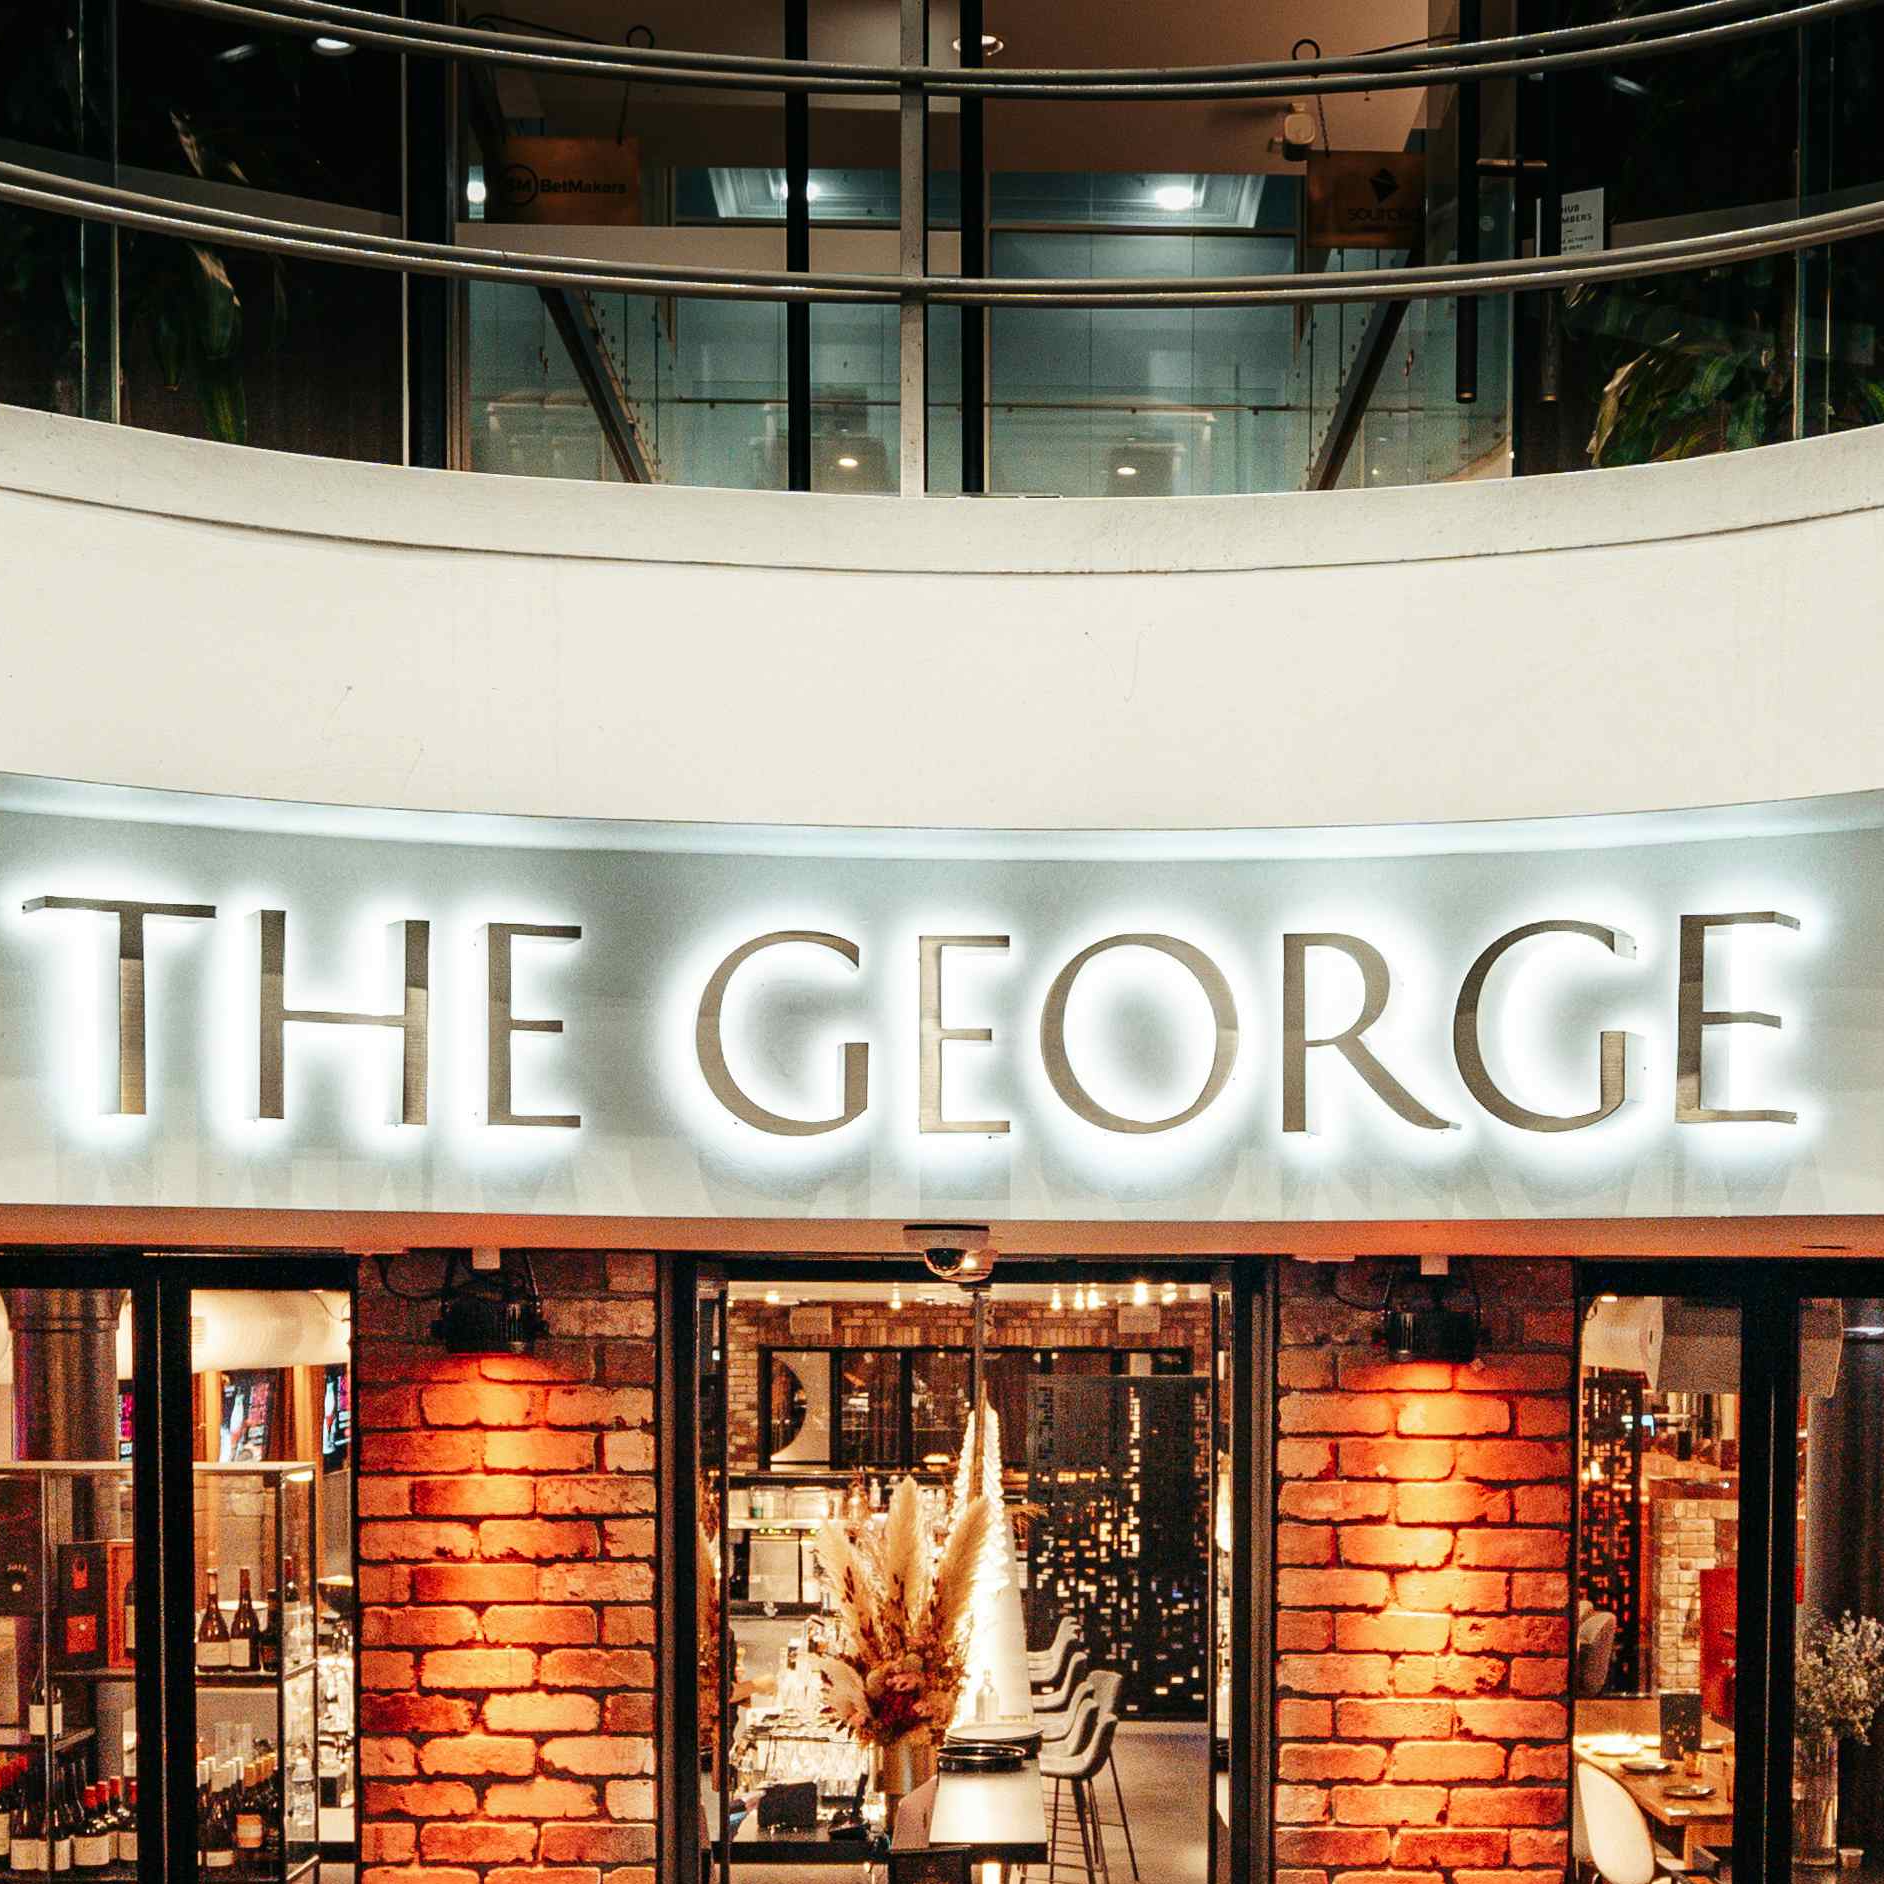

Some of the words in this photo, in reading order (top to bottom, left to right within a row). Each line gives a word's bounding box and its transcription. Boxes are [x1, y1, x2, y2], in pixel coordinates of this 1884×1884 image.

[540, 178, 628, 194] BetMakers
[21, 895, 582, 1129] THE
[695, 910, 1801, 1136] GEORGE
